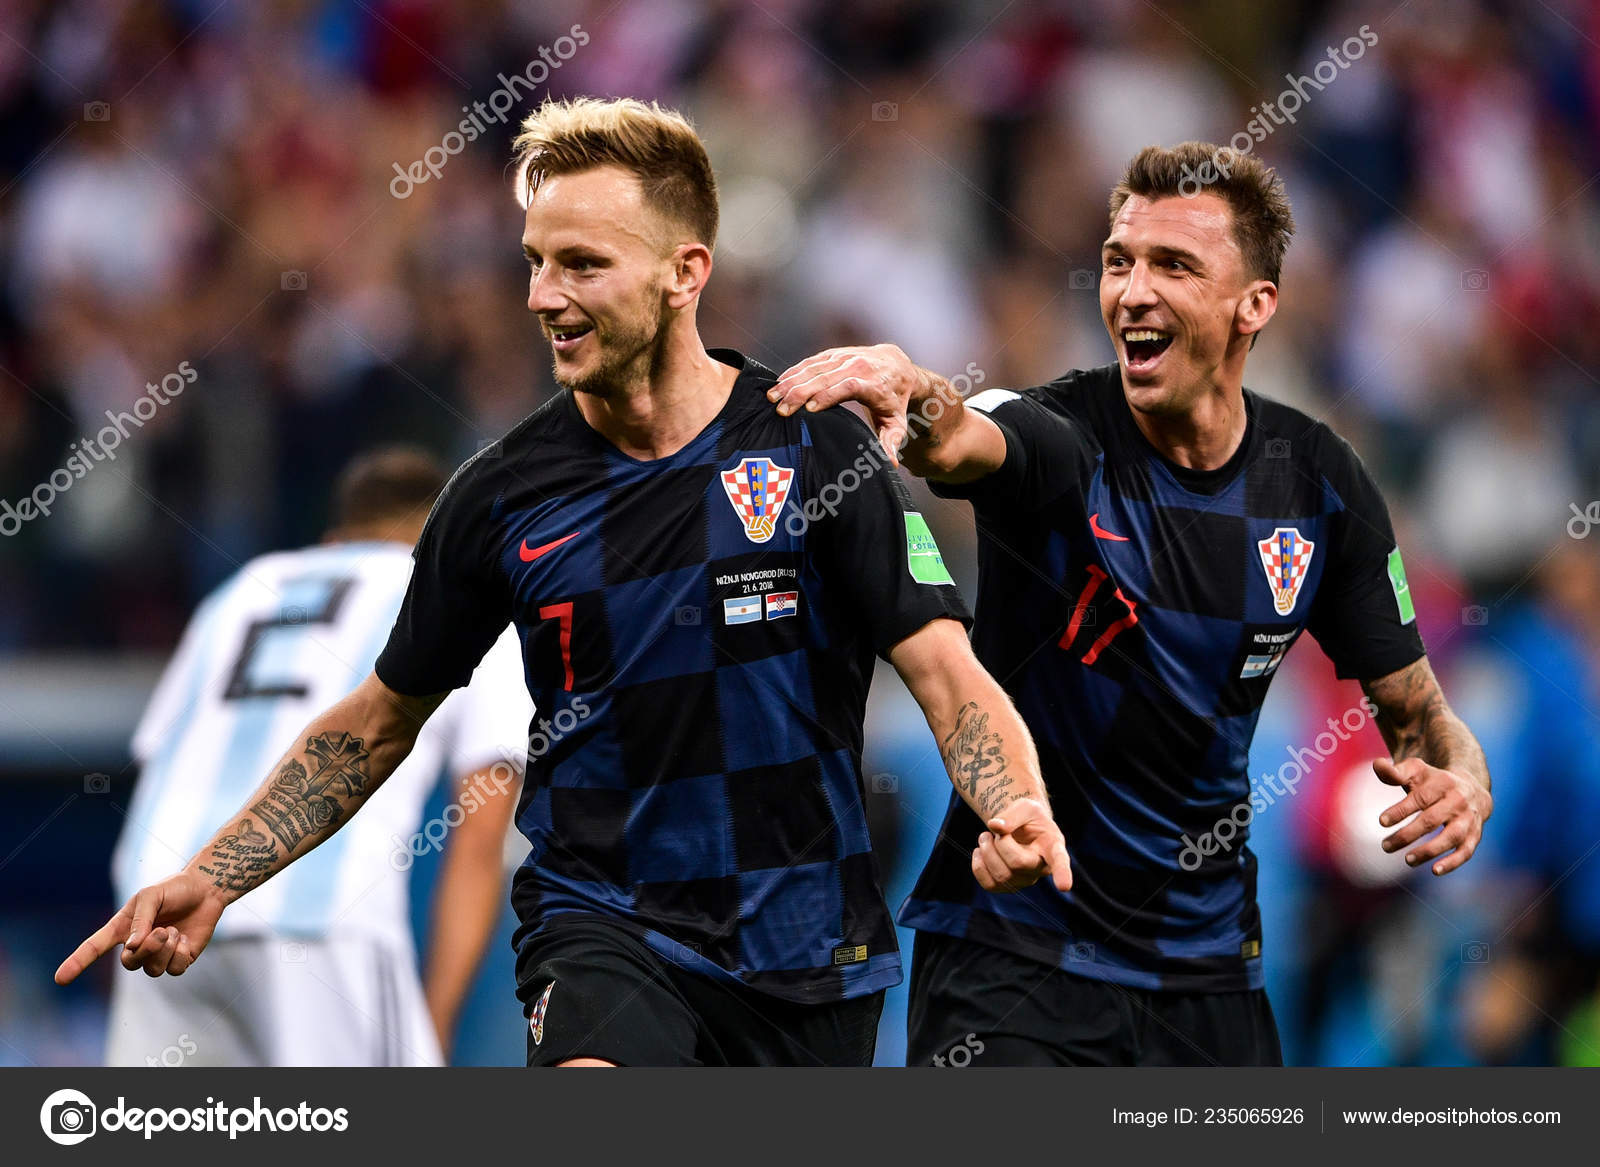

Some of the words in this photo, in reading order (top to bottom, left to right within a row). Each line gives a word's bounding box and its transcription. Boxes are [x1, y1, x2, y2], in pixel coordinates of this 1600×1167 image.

[740, 570, 776, 581] NOVGOROD
[1058, 563, 1139, 666] 17
[223, 577, 358, 701] 2
[539, 602, 575, 692] 7
